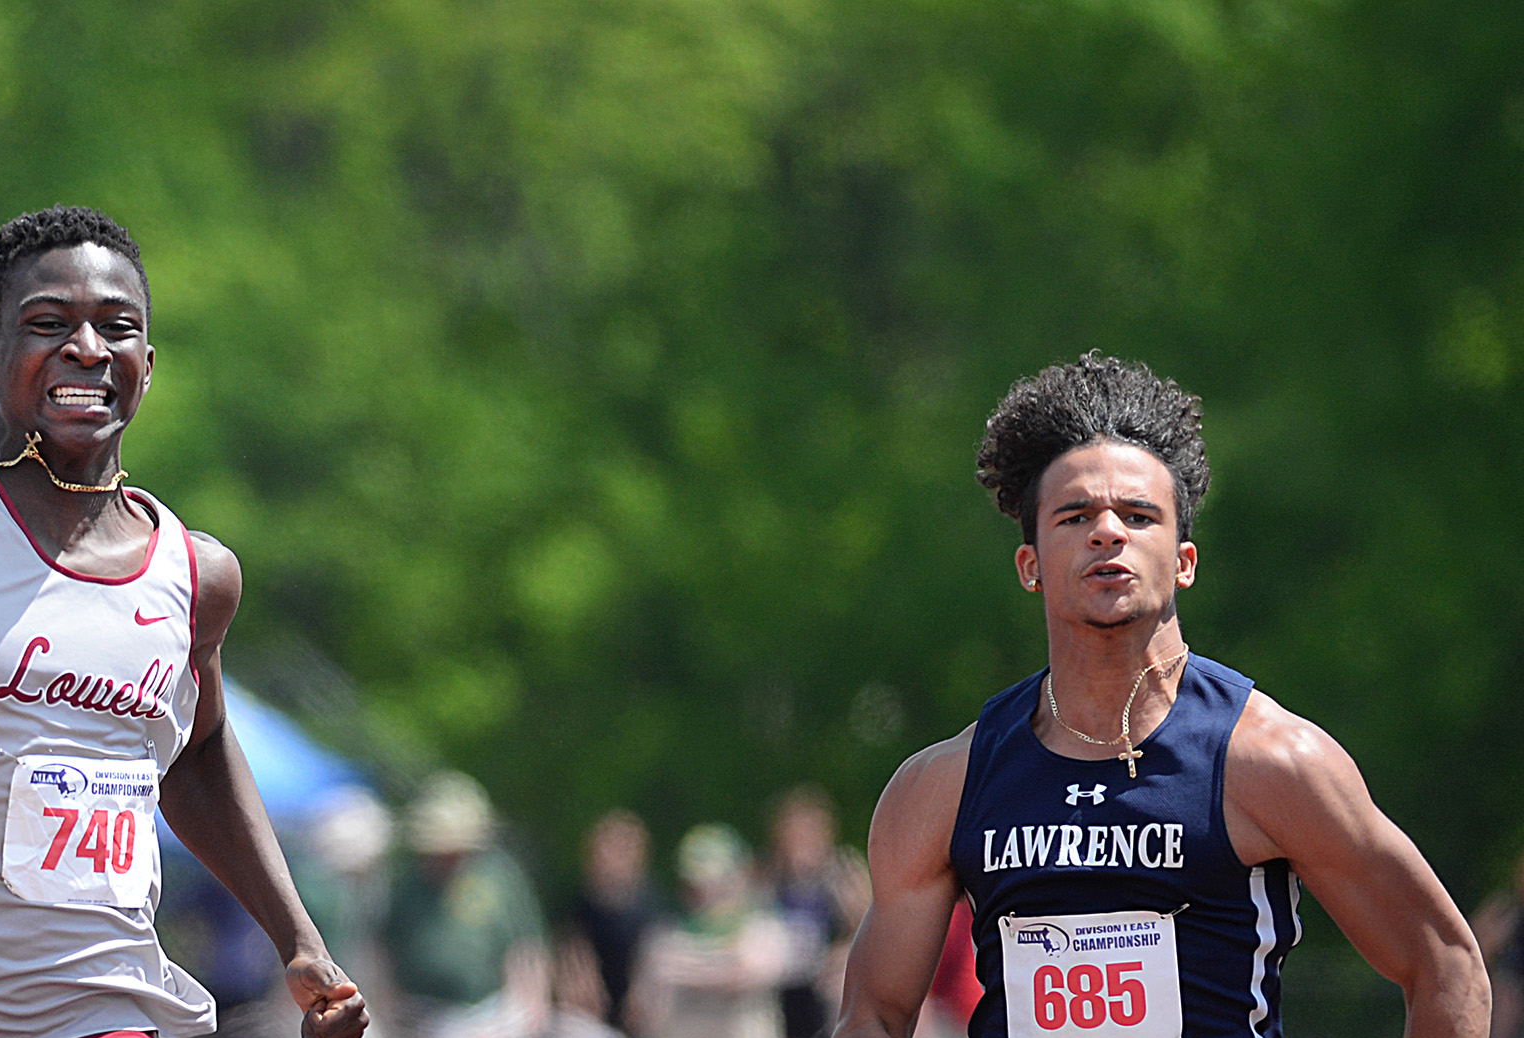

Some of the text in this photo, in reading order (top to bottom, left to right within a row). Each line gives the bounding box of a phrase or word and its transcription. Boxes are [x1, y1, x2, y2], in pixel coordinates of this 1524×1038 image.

[32, 772, 62, 784] MIAA
[95, 771, 130, 780] DIVISION
[137, 773, 154, 781] EAST
[91, 782, 154, 797] CHAMPIONSHIP
[41, 807, 136, 874] 740
[983, 823, 1184, 872] LAWRENCE
[1075, 923, 1122, 936] DIVISION
[1130, 921, 1157, 931] EAST
[1019, 932, 1046, 942] MIAA
[1073, 932, 1161, 952] CHAMPIONSHIP
[1033, 961, 1147, 1031] 685
